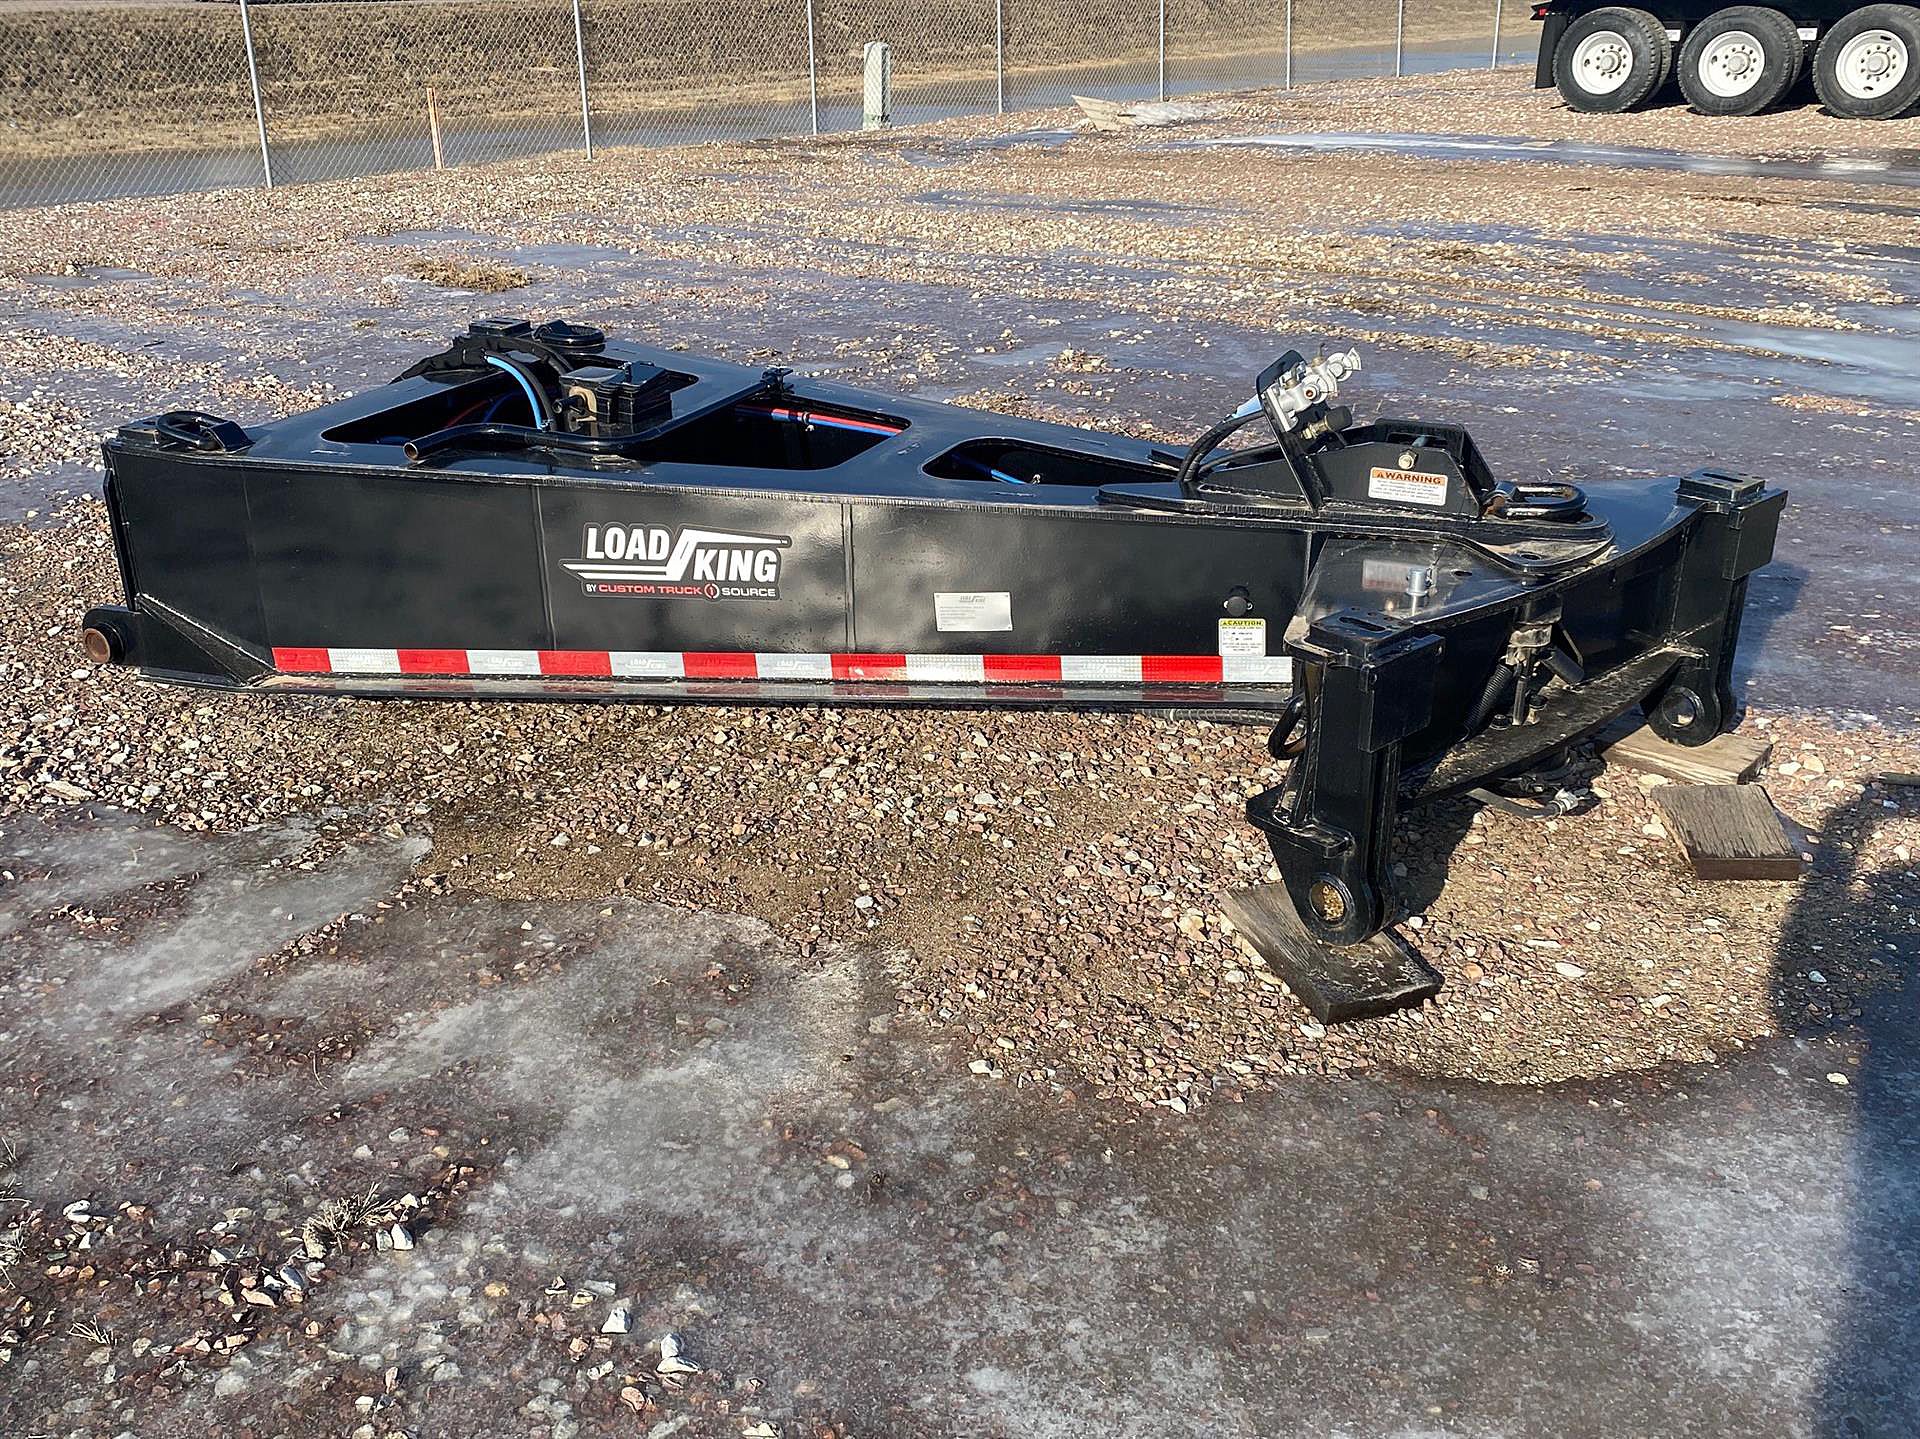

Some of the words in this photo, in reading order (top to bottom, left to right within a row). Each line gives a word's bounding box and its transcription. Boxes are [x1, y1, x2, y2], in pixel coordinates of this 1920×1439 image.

[1386, 472, 1441, 484] WARNING
[586, 527, 670, 561] LOAD
[692, 549, 777, 582] KING
[586, 583, 597, 593] BY
[599, 584, 655, 594] CUSTOM
[658, 586, 703, 595] TRUCK
[722, 588, 777, 597] SOURCE
